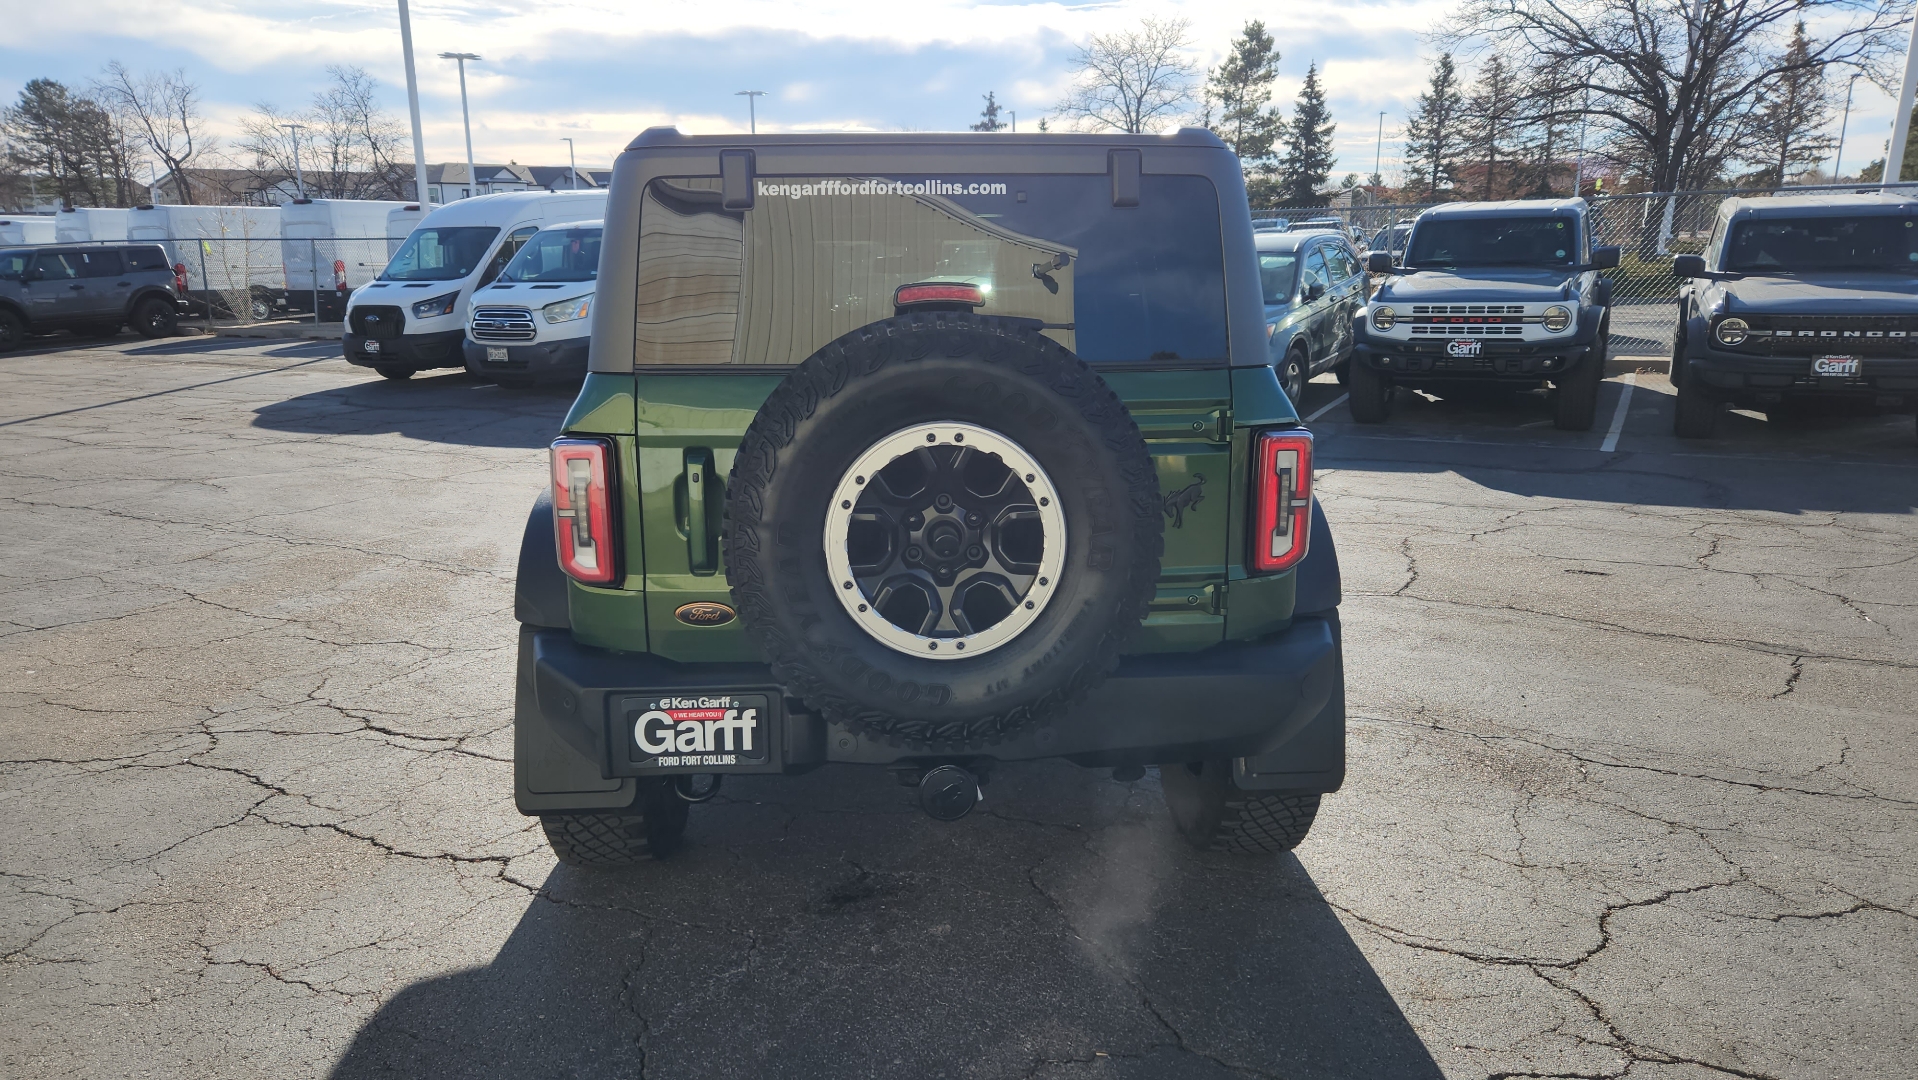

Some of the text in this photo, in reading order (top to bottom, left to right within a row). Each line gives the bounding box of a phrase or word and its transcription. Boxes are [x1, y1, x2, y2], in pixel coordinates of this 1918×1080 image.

[758, 179, 1006, 200] kengarfffordfortcollins.com
[1447, 342, 1482, 355] Garff
[1814, 358, 1859, 373] Garff
[689, 607, 721, 621] Ford
[672, 696, 731, 709] Ken Garff
[634, 708, 757, 755] Garff
[658, 754, 736, 767] FORD FORT COLLINS
